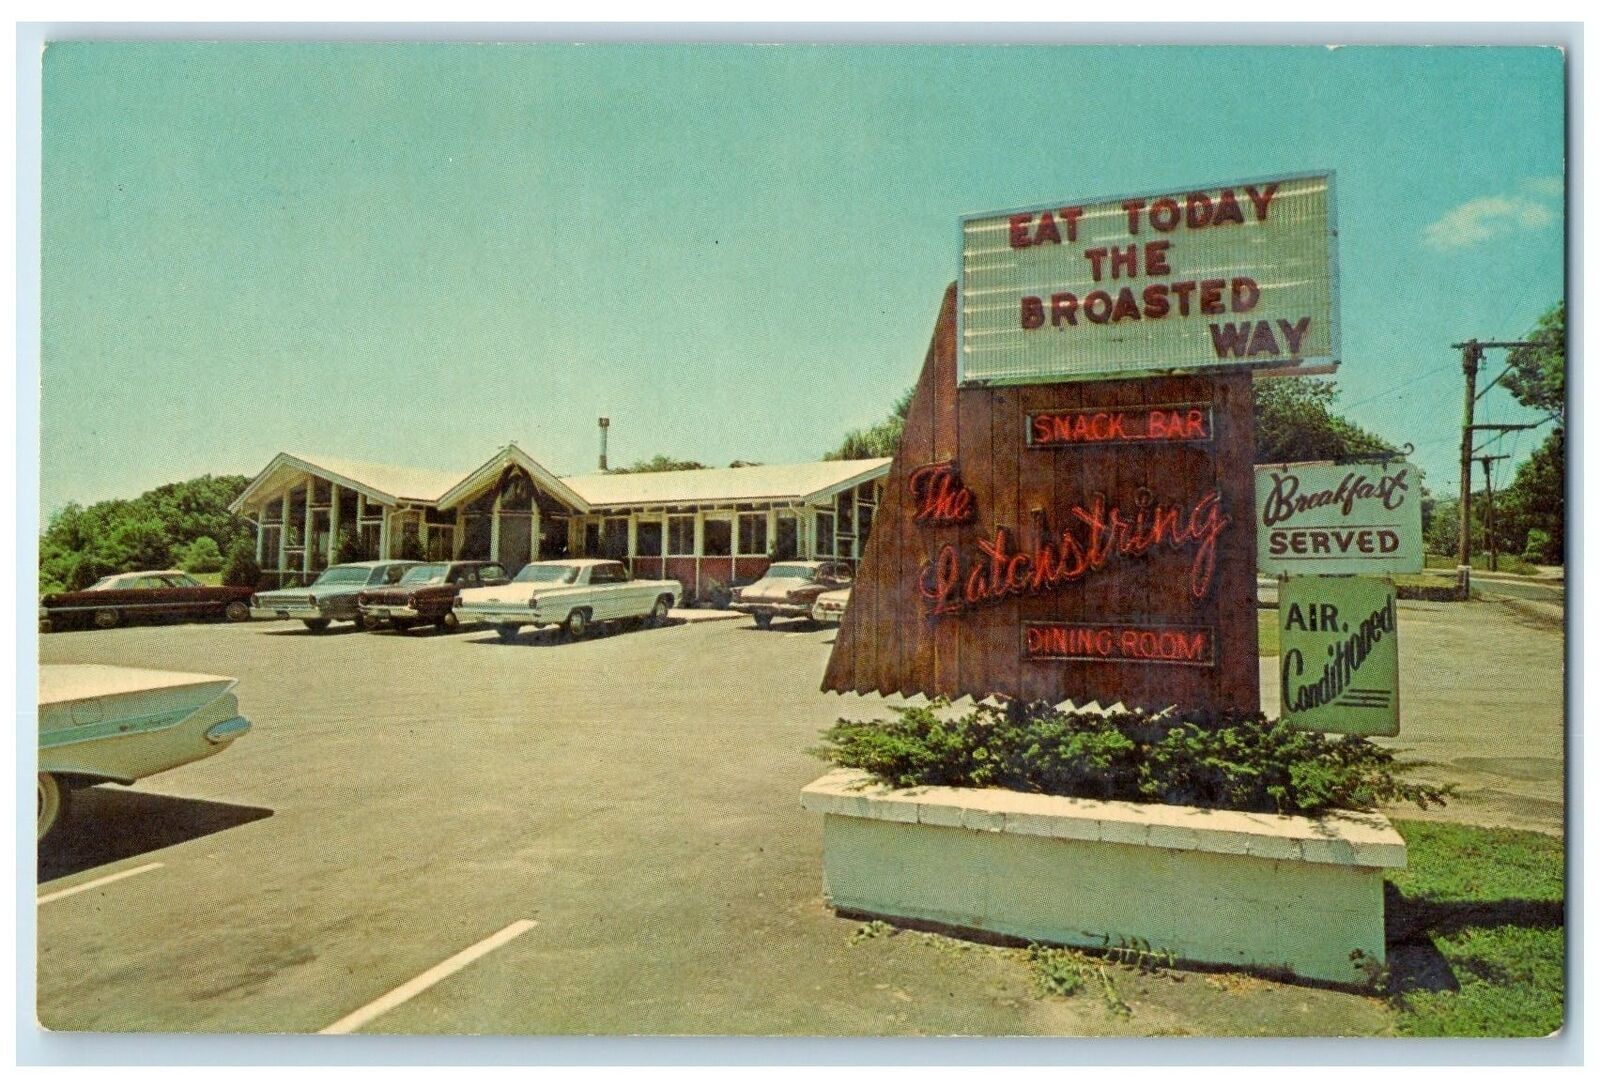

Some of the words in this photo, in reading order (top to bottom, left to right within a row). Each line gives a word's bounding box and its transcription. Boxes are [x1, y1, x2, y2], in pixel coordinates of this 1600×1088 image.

[1008, 206, 1083, 249] EAT
[1122, 184, 1278, 235] TODAY
[1084, 240, 1171, 281] THE
[1020, 277, 1260, 329] BROASTED
[1209, 317, 1311, 358] WAY
[1034, 412, 1125, 442] SNACK
[1149, 410, 1207, 438] BAR
[908, 460, 973, 522] The
[1263, 469, 1408, 527] Breakfast
[919, 488, 1229, 614] Latchstring
[1269, 530, 1400, 554] SERVED
[1027, 628, 1112, 653] DINING
[1122, 631, 1205, 659] ROOM
[1282, 594, 1393, 713] Conditioned
